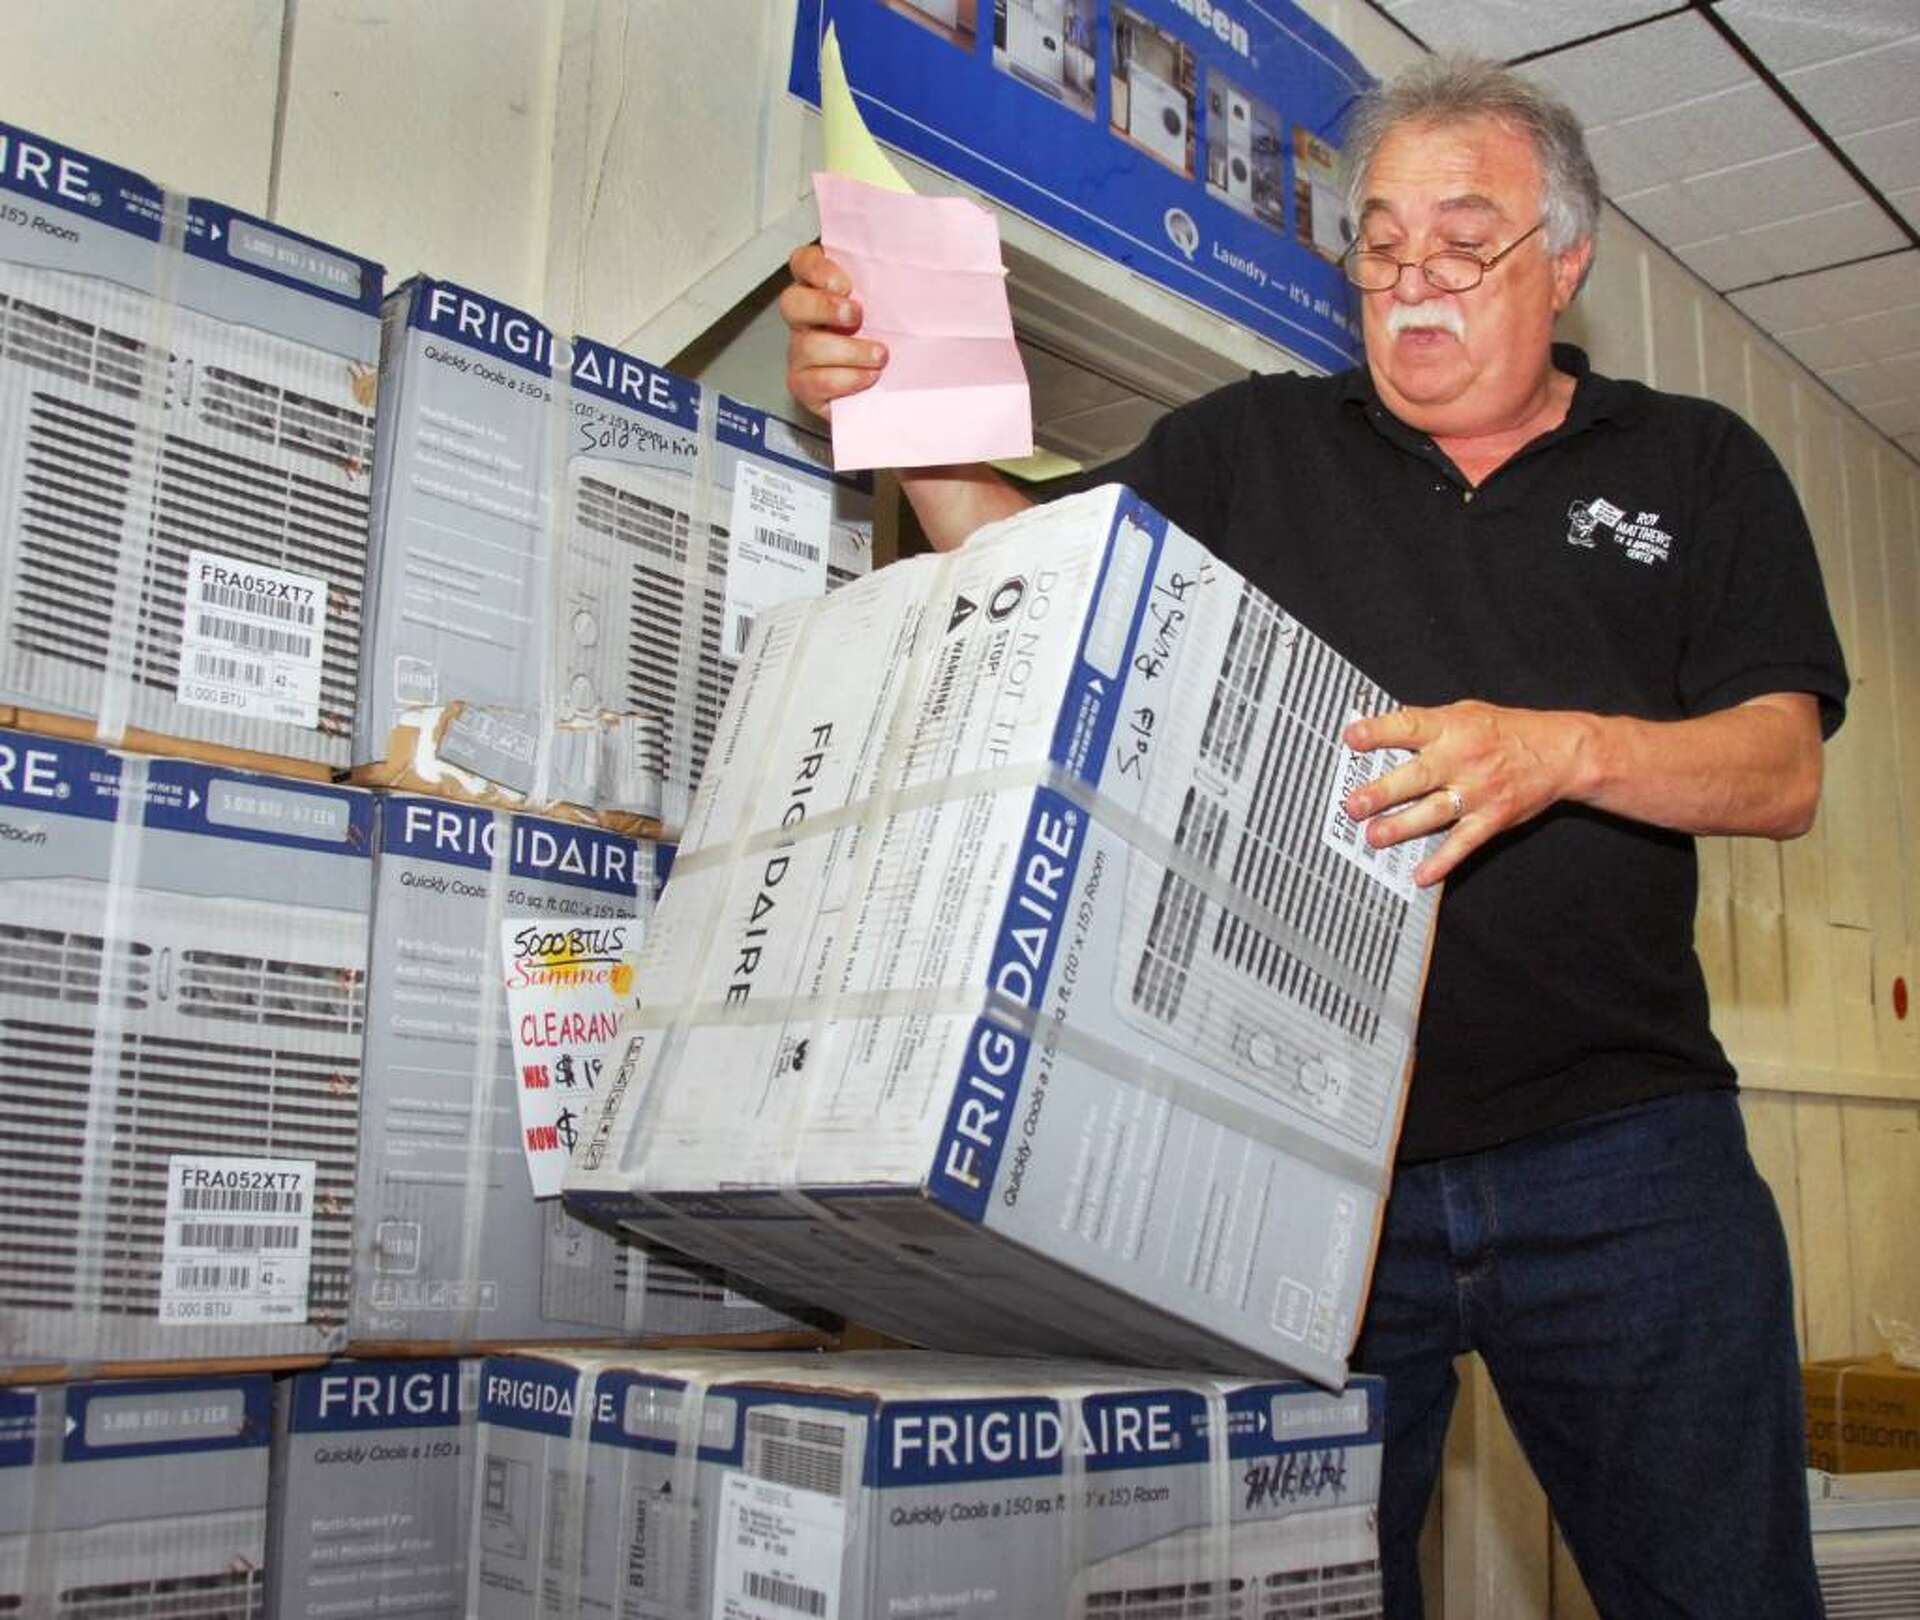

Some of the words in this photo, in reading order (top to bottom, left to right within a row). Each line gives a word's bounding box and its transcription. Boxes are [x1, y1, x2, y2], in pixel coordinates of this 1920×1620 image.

[32, 217, 80, 243] Room
[1213, 241, 1267, 287] Laundry
[424, 346, 469, 373] Quickly
[473, 361, 505, 388] Cools
[580, 421, 630, 452] Sold
[201, 565, 314, 604] FRA052XT7
[1028, 570, 1058, 620] DO
[1004, 632, 1040, 698] NOT
[1117, 708, 1155, 780] Sold
[724, 722, 834, 1010] FRIGIDAIRE
[401, 872, 449, 893] Quickly
[452, 879, 488, 898] Cools
[507, 889, 526, 905] 50
[507, 959, 630, 989] Summer
[946, 810, 1070, 1190] FRIGIDAIRE
[520, 1012, 624, 1047] CLEARAN
[1003, 1142, 1031, 1208] Quickly
[1022, 1088, 1047, 1139] Cools
[1088, 850, 1107, 902] Room
[523, 1063, 549, 1089] WAS
[527, 1126, 558, 1150] NOW
[181, 1169, 301, 1190] FRA052XT7
[487, 1374, 616, 1423] FRIGIDAE
[314, 1448, 365, 1465] Quickly
[370, 1445, 408, 1461] Cools
[892, 1405, 1171, 1469] FRIGIDAIRE
[890, 1506, 945, 1526] Quickly
[950, 1503, 989, 1521] Cools
[1004, 1498, 1032, 1516] 150
[1134, 1484, 1171, 1503] Room
